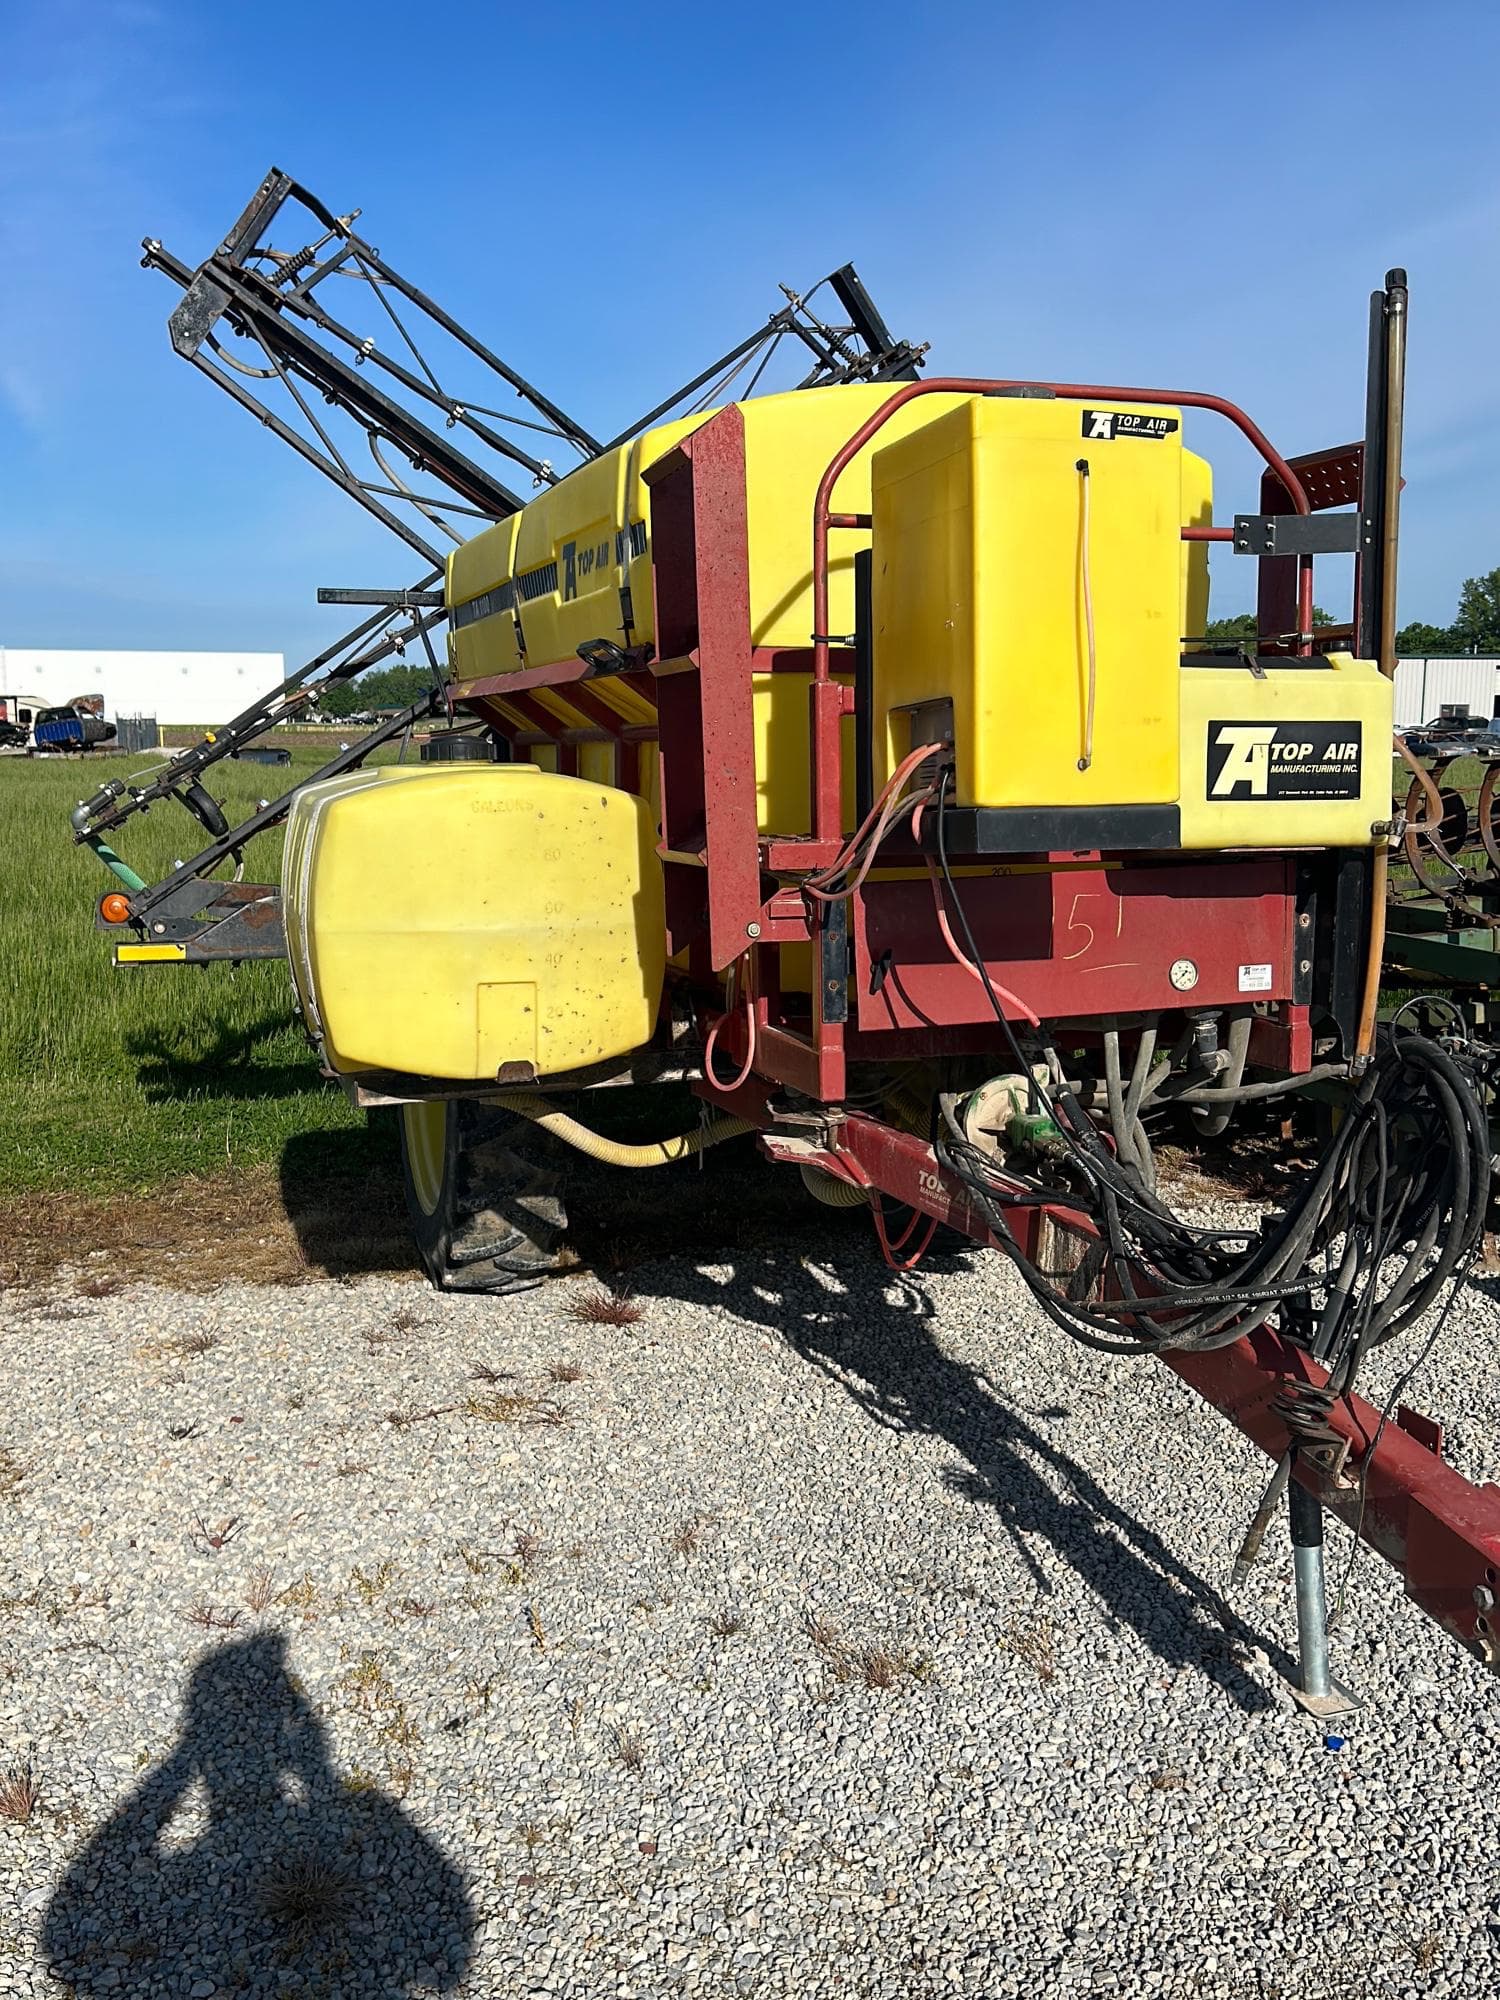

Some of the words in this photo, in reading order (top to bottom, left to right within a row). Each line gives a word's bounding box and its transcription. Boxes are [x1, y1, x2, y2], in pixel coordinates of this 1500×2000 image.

[1117, 415, 1141, 427] TOP
[1147, 419, 1168, 431] AIR
[578, 548, 594, 577] TOP
[596, 542, 609, 570] AIR
[1270, 743, 1314, 761] TOP
[1322, 743, 1359, 761] AIR
[1270, 764, 1341, 773] MANUFACTURING
[1342, 764, 1358, 773] INC.
